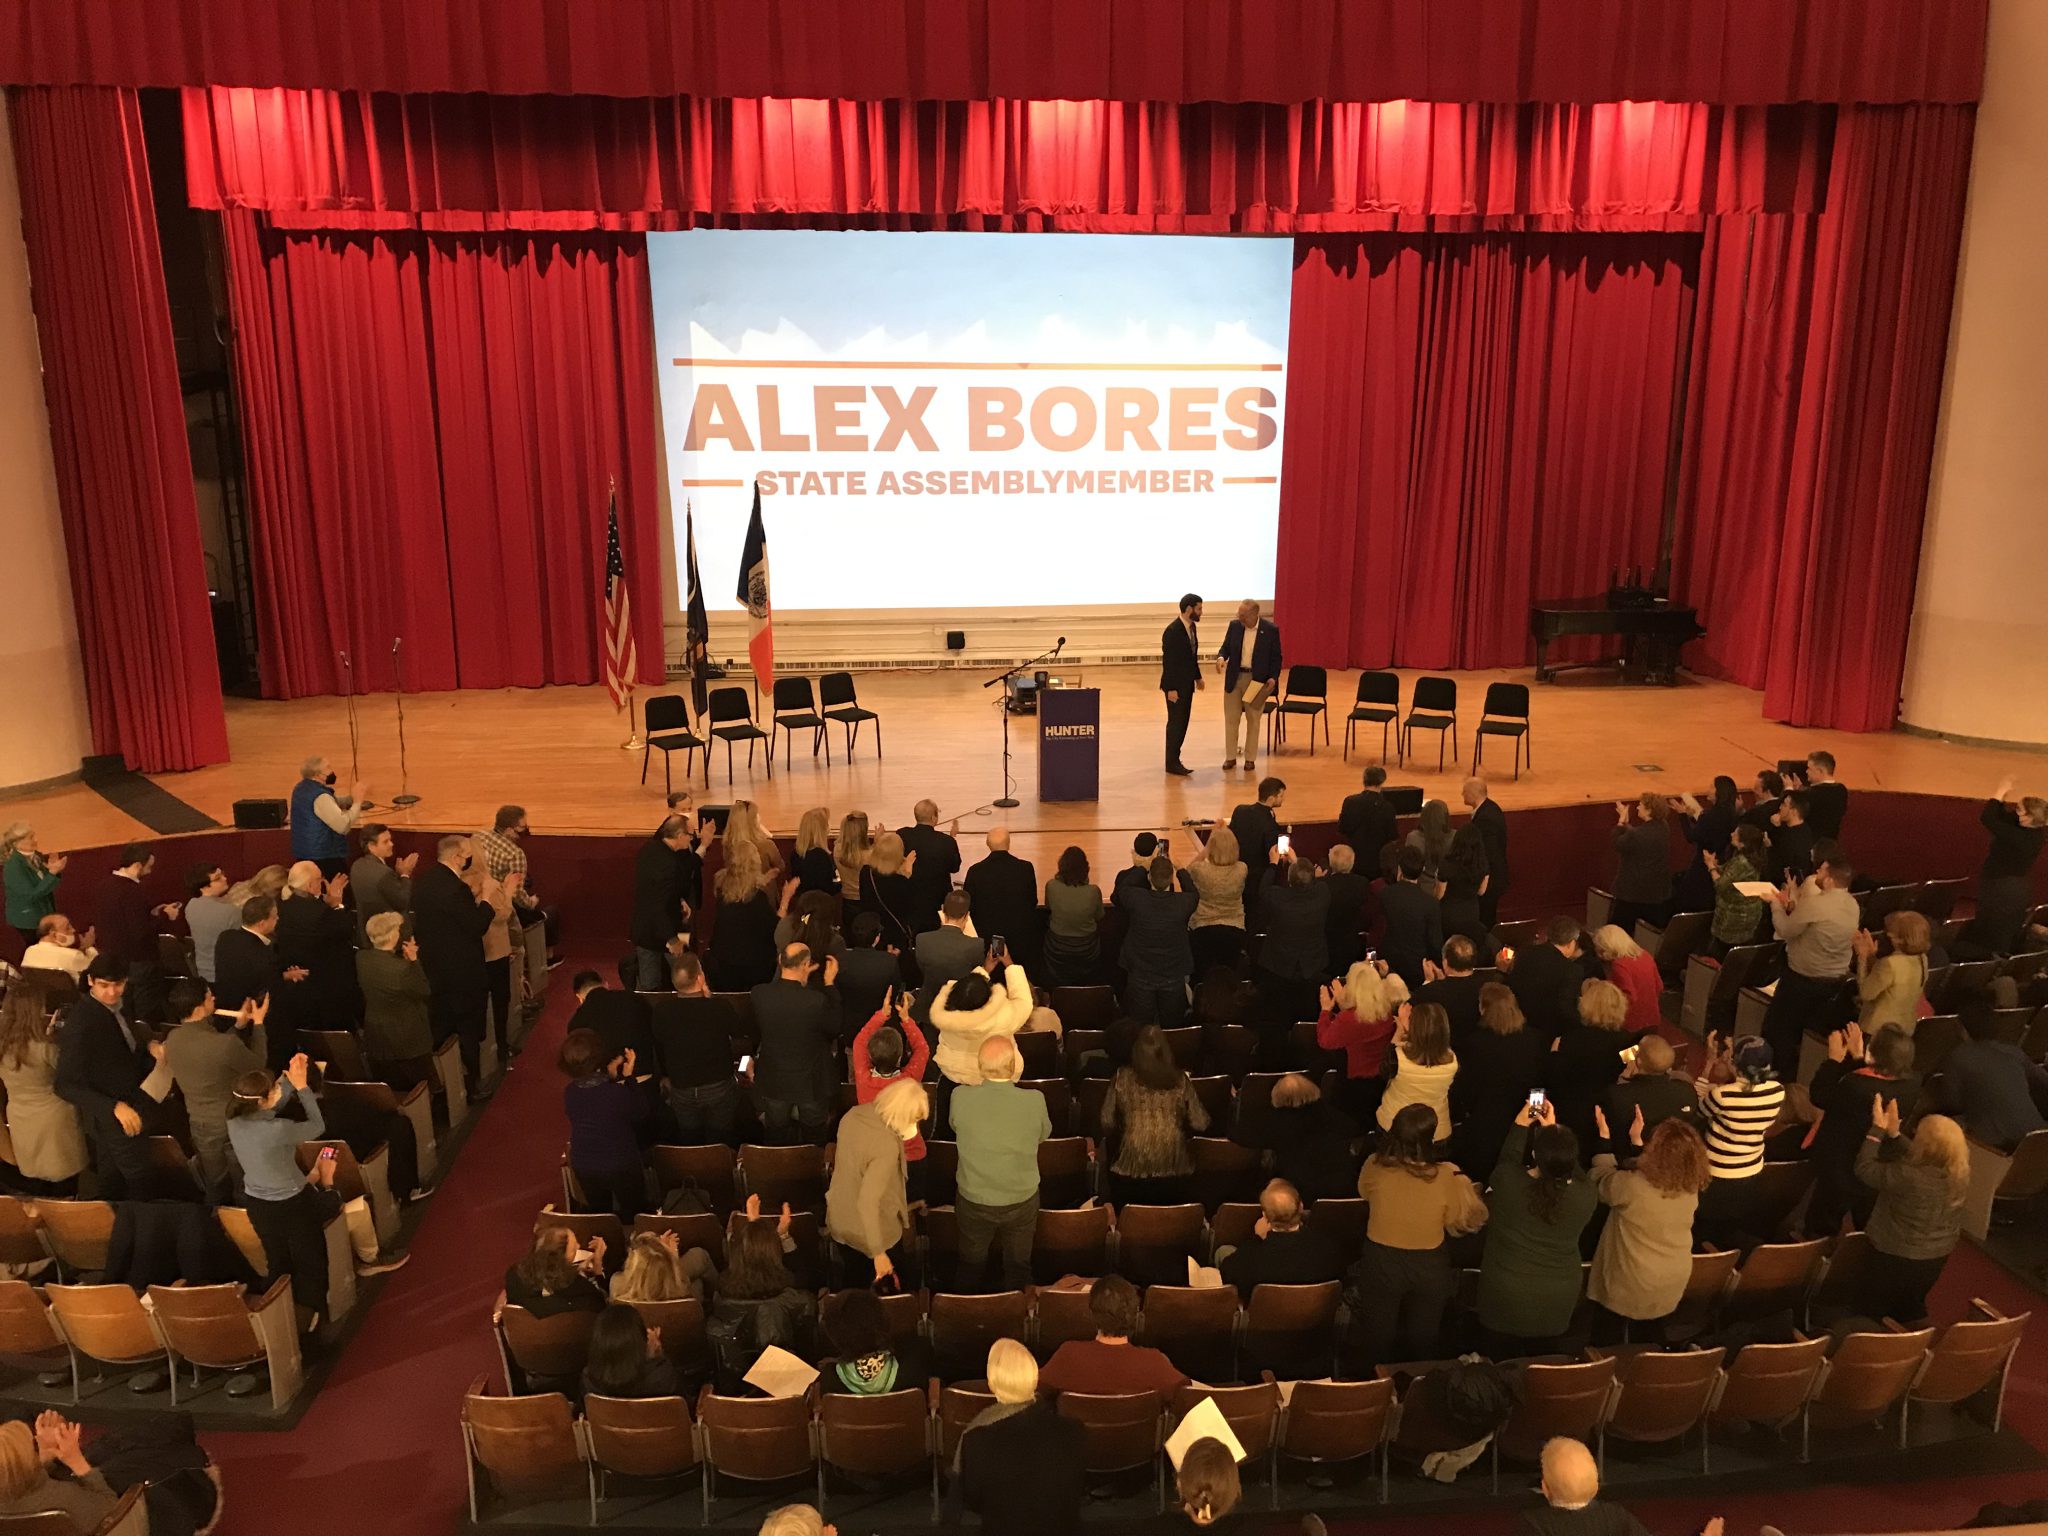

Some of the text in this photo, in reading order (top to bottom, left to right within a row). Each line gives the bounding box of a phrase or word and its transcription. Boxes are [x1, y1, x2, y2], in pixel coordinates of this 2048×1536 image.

[682, 383, 1278, 452] ALEX BORES
[755, 469, 1214, 496] STATE ASSEMBLYMEMBER
[1045, 725, 1095, 737] HUNTER
